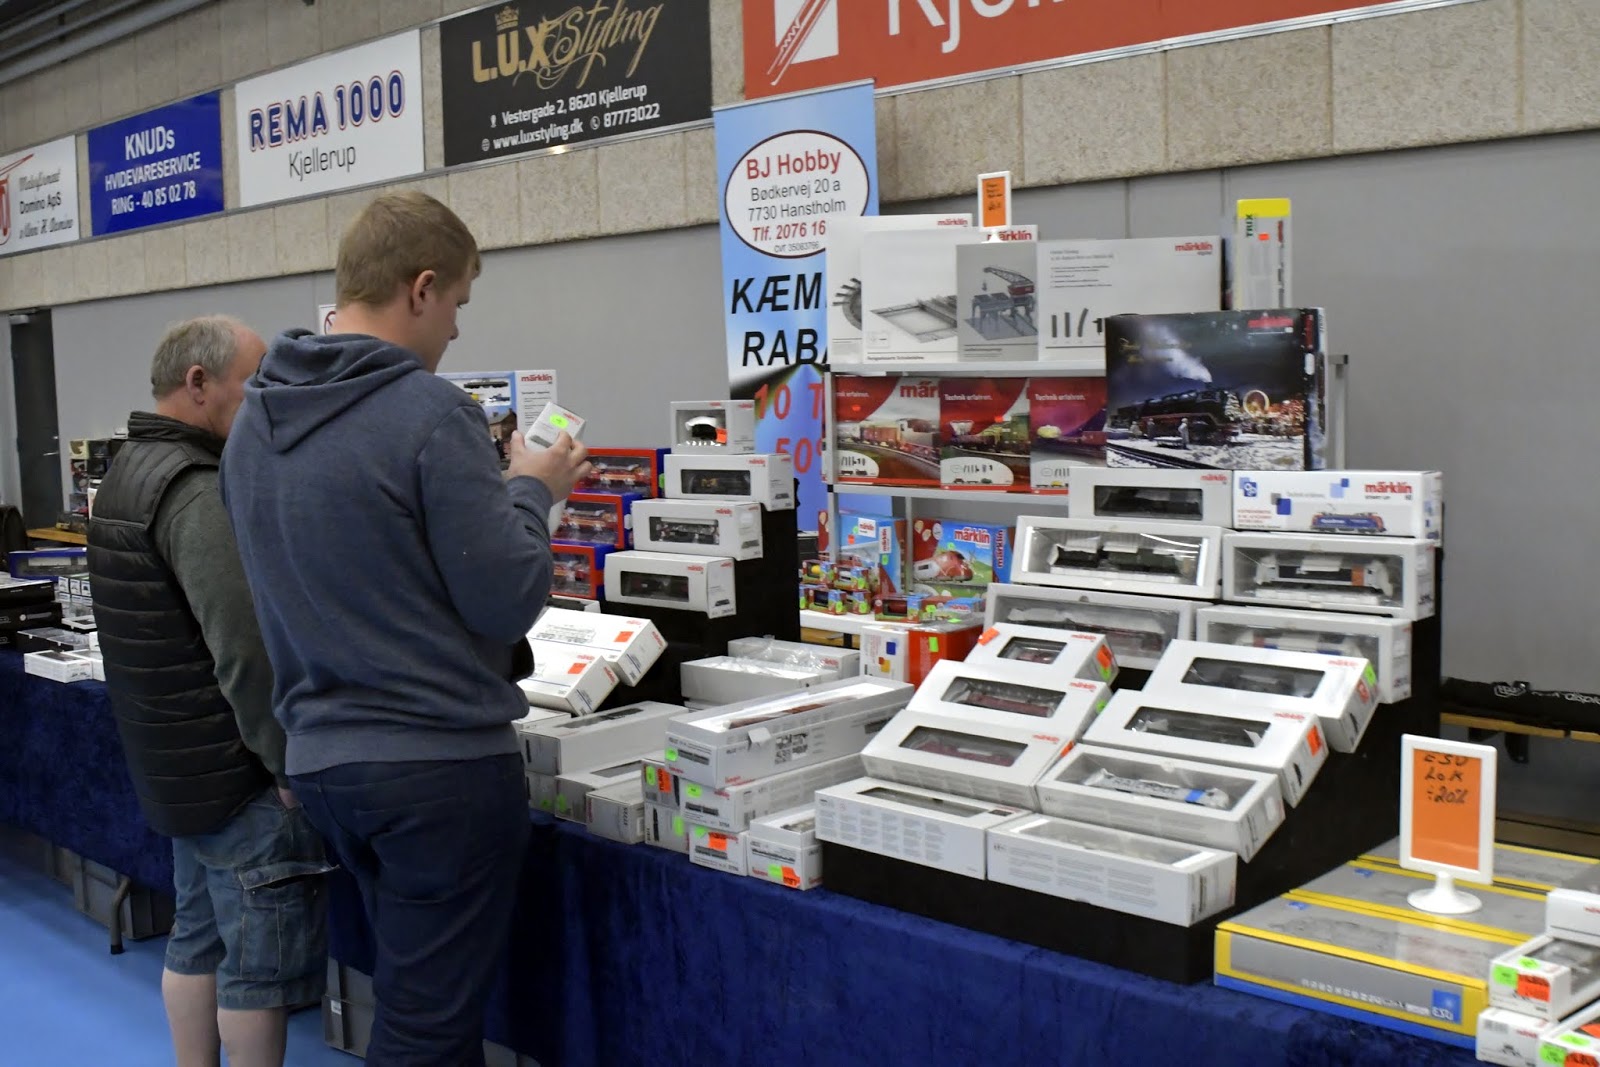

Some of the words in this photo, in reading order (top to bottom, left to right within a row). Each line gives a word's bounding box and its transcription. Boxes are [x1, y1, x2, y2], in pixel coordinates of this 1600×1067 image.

[249, 91, 329, 152] REMA
[334, 70, 405, 131] 1000
[502, 101, 555, 125] Vestergade
[568, 92, 597, 112] 8620
[599, 84, 648, 108] Kjellerup
[124, 125, 175, 160] KNUDs
[493, 118, 584, 149] www.luxstyling.dk
[603, 103, 660, 128] 87773022
[104, 151, 201, 192] HVIDEVARESERVICE
[288, 145, 357, 181] Kjellerup
[746, 156, 771, 180] BJ
[777, 149, 841, 175] Hobby
[111, 194, 135, 216] RING
[141, 190, 154, 208] 40
[154, 187, 167, 206] 85
[168, 183, 182, 203] 02
[183, 180, 197, 200] 78
[750, 181, 812, 202] Bødkervej
[814, 178, 830, 194] 20
[832, 179, 841, 192] a
[748, 205, 777, 222] 7730
[780, 198, 847, 218] Hanstholm
[752, 227, 772, 242] Tlf.
[776, 222, 807, 240] 2076
[811, 220, 827, 236] 16
[1175, 242, 1213, 251] märklin
[732, 272, 827, 315] KÆM
[742, 329, 827, 367] RAB
[521, 374, 553, 382] märklin
[900, 381, 939, 398] mär
[755, 383, 792, 420] 10
[1364, 482, 1413, 494] märklin
[954, 526, 991, 545] märklin
